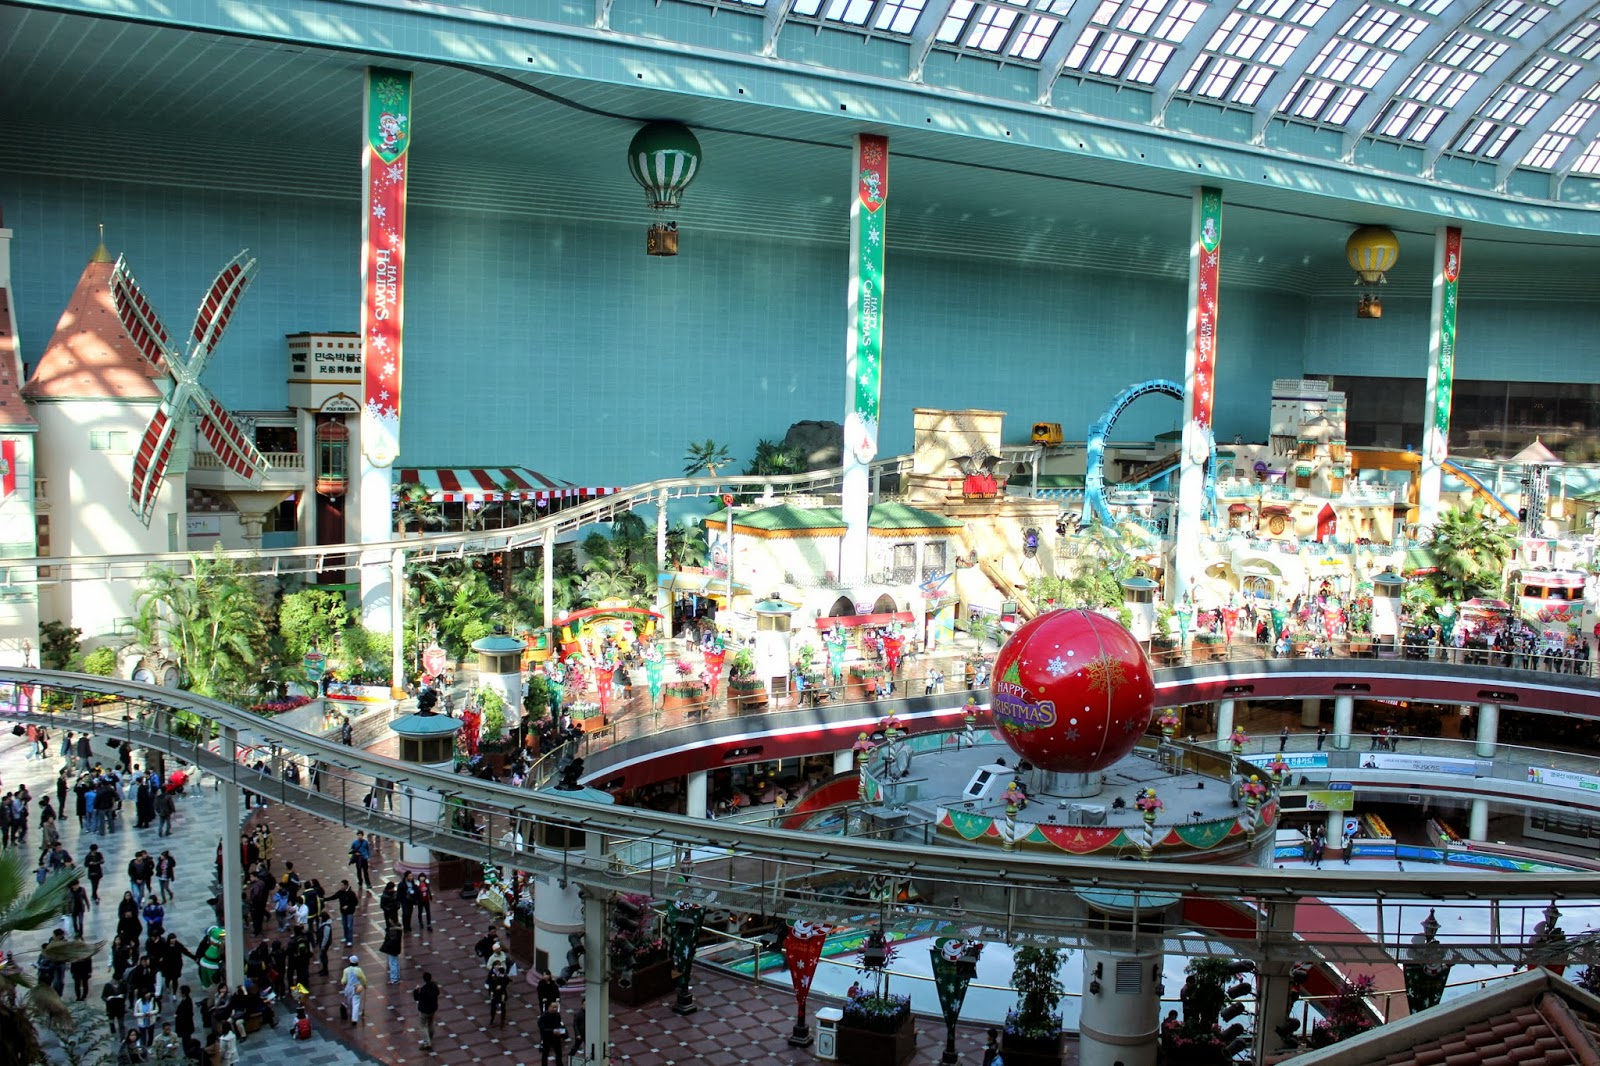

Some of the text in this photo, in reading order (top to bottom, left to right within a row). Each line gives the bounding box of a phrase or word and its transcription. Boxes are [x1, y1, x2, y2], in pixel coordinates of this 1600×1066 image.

[375, 248, 391, 321] HOLIDAYS
[387, 265, 397, 305] HAPPY
[862, 280, 873, 347] CHRISTMAS
[997, 681, 1028, 699] HAPPY
